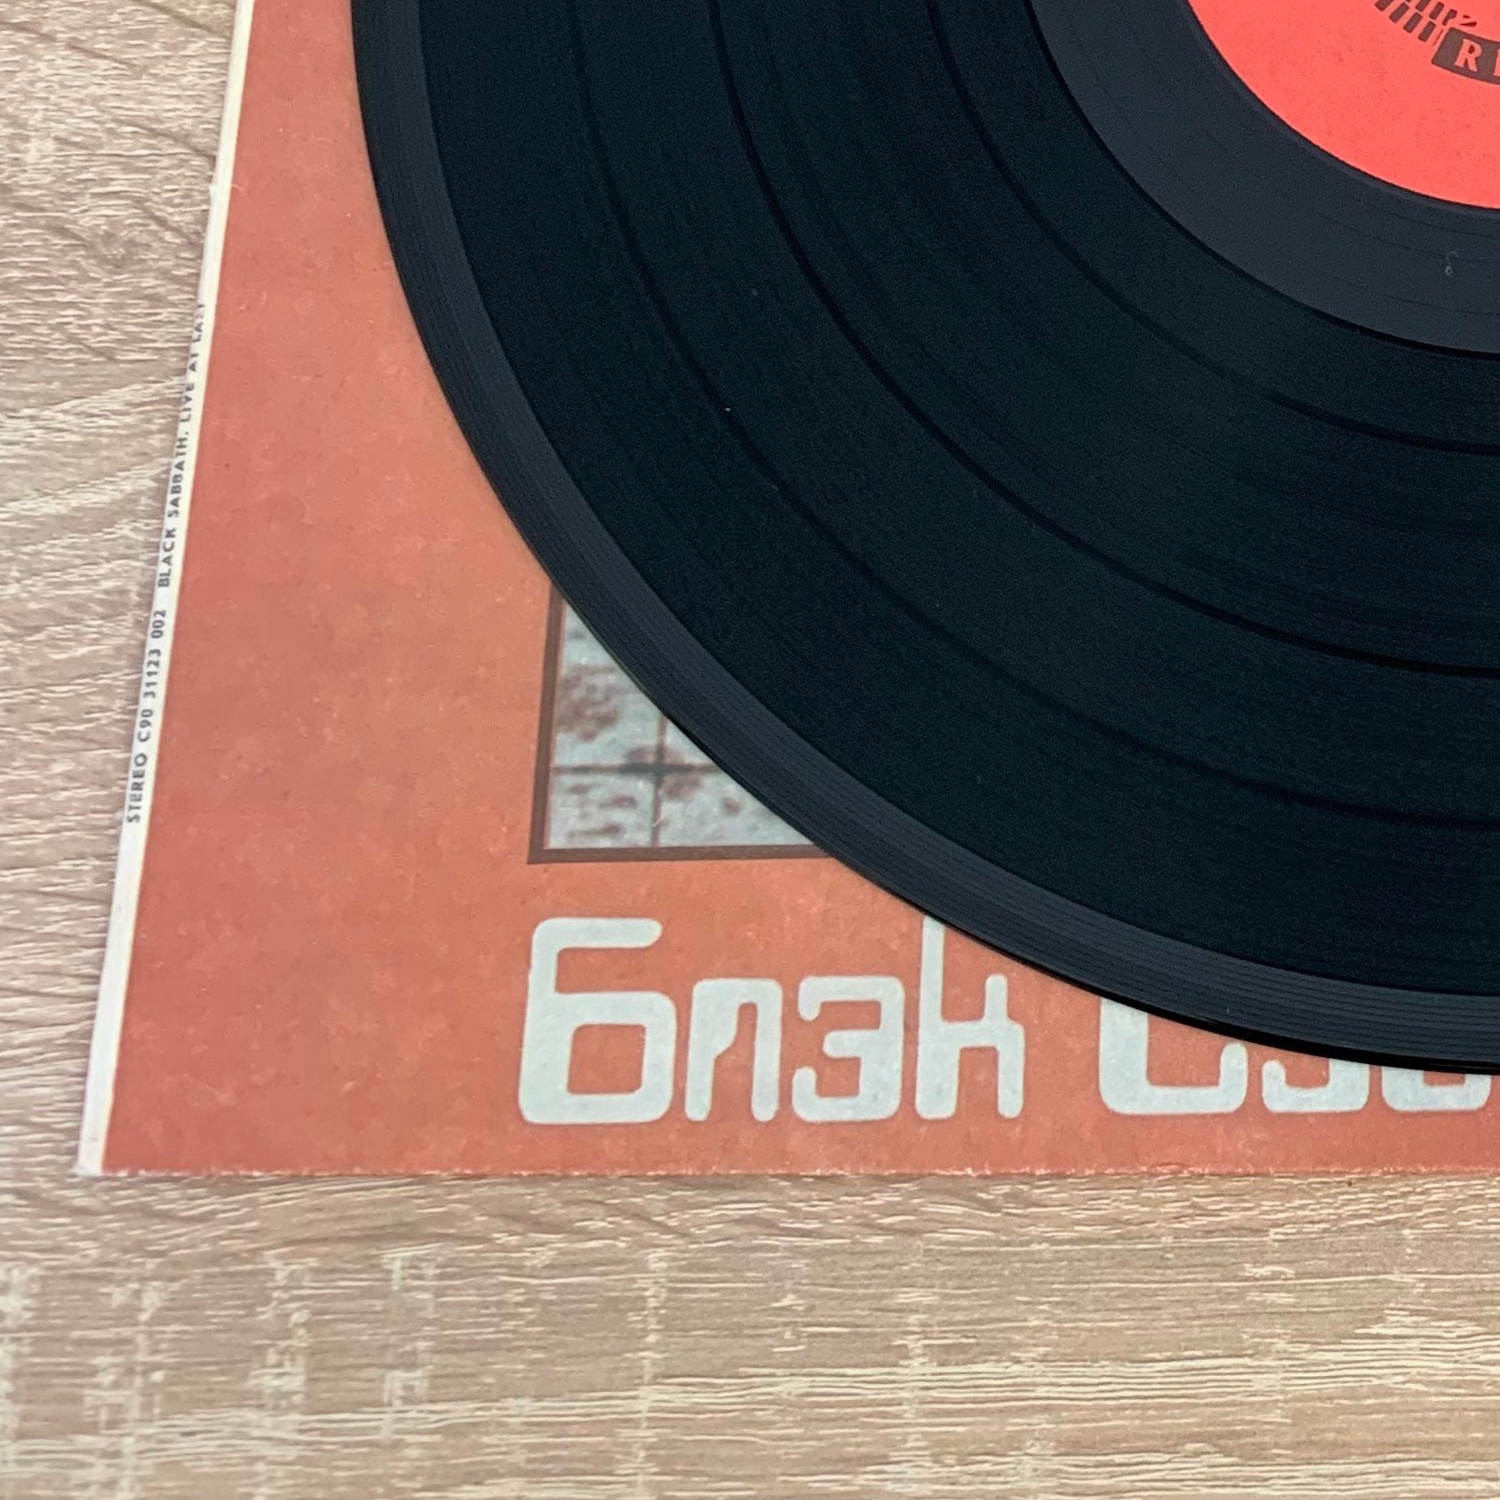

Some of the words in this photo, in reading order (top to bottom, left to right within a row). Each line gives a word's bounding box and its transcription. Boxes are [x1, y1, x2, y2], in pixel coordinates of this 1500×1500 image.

[179, 383, 195, 422] LIVE
[157, 527, 177, 588] BLACK
[151, 609, 167, 639] 002
[142, 648, 162, 699] 31123
[126, 753, 148, 824] STEREO
